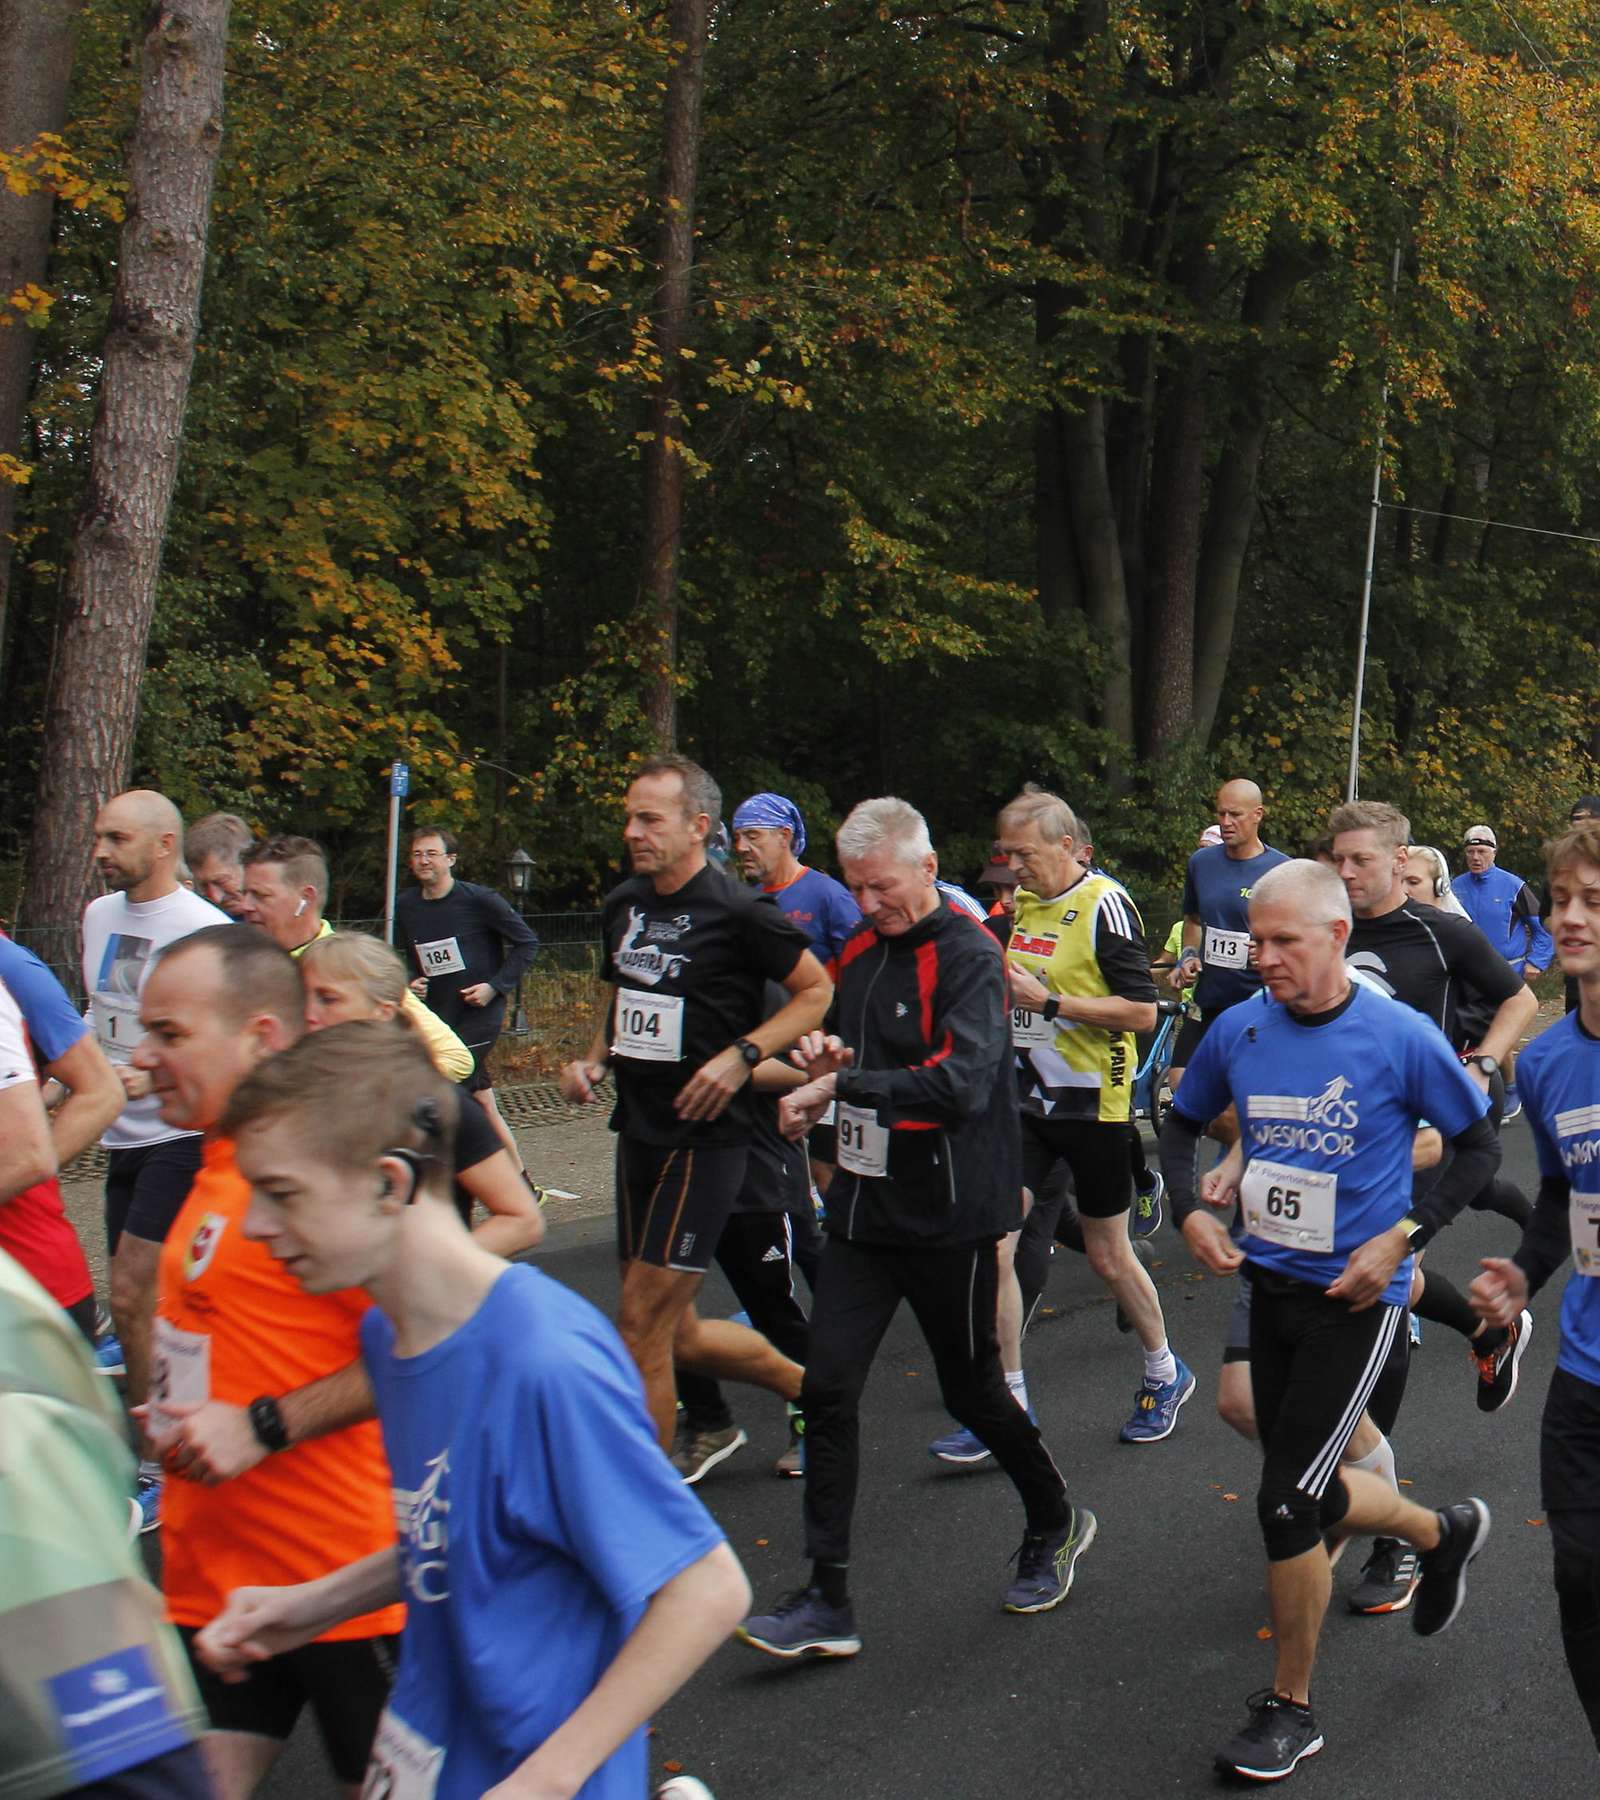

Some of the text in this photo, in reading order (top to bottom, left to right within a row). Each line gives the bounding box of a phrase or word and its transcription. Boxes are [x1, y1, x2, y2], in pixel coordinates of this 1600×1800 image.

[425, 949, 451, 965] 184
[1212, 939, 1237, 956] 113
[622, 1008, 661, 1037] 104
[841, 1119, 864, 1150] 91
[1267, 1186, 1301, 1220] 65
